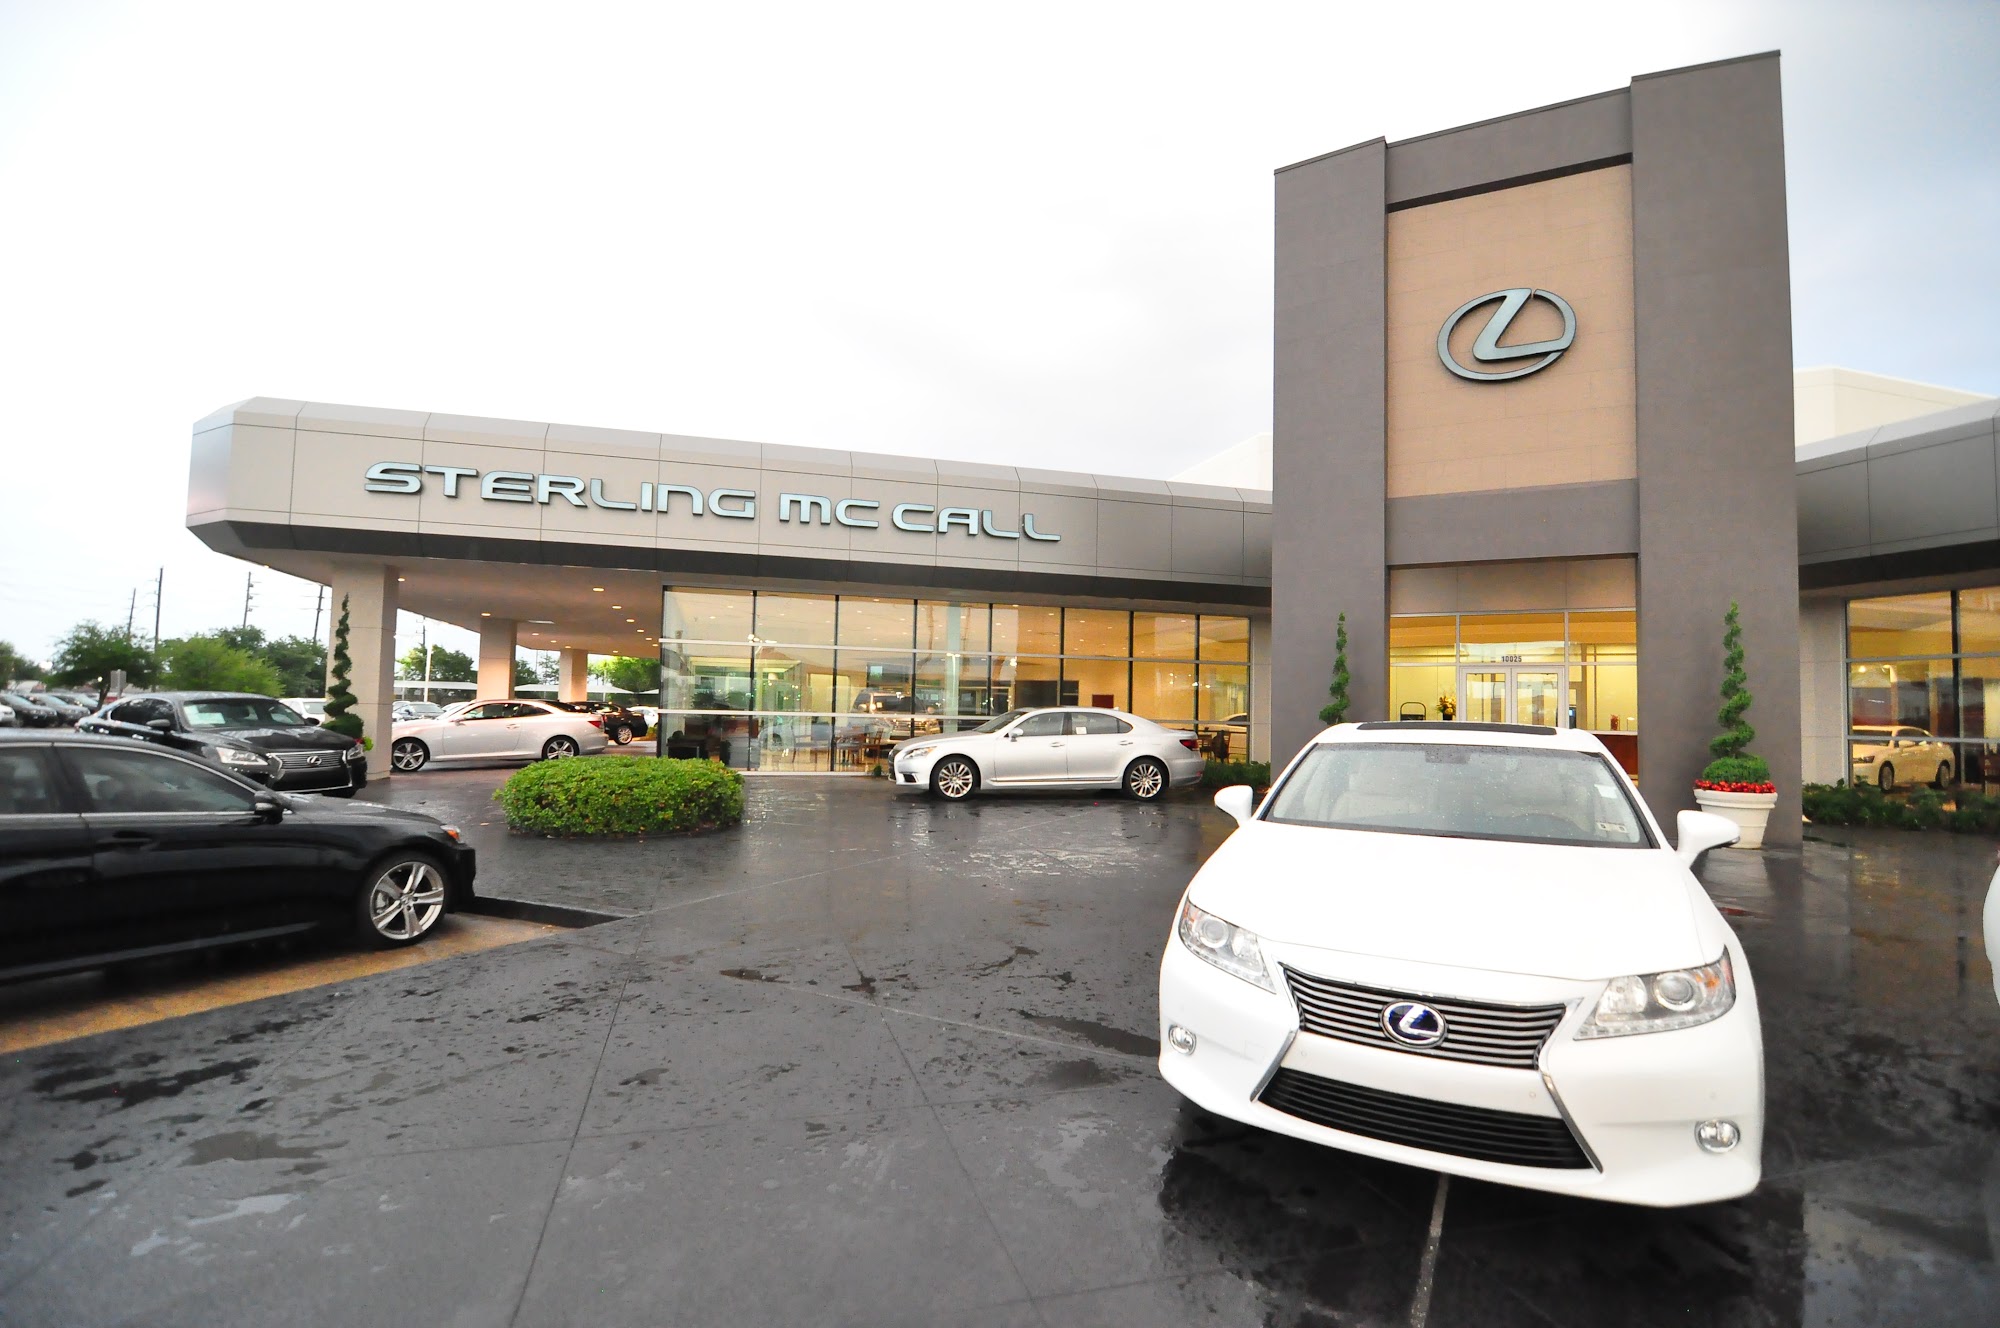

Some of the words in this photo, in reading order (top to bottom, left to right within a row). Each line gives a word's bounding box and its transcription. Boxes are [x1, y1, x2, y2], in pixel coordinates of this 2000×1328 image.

[364, 461, 757, 520] STERLING
[892, 503, 1062, 542] CALL
[1501, 655, 1522, 663] 10025
